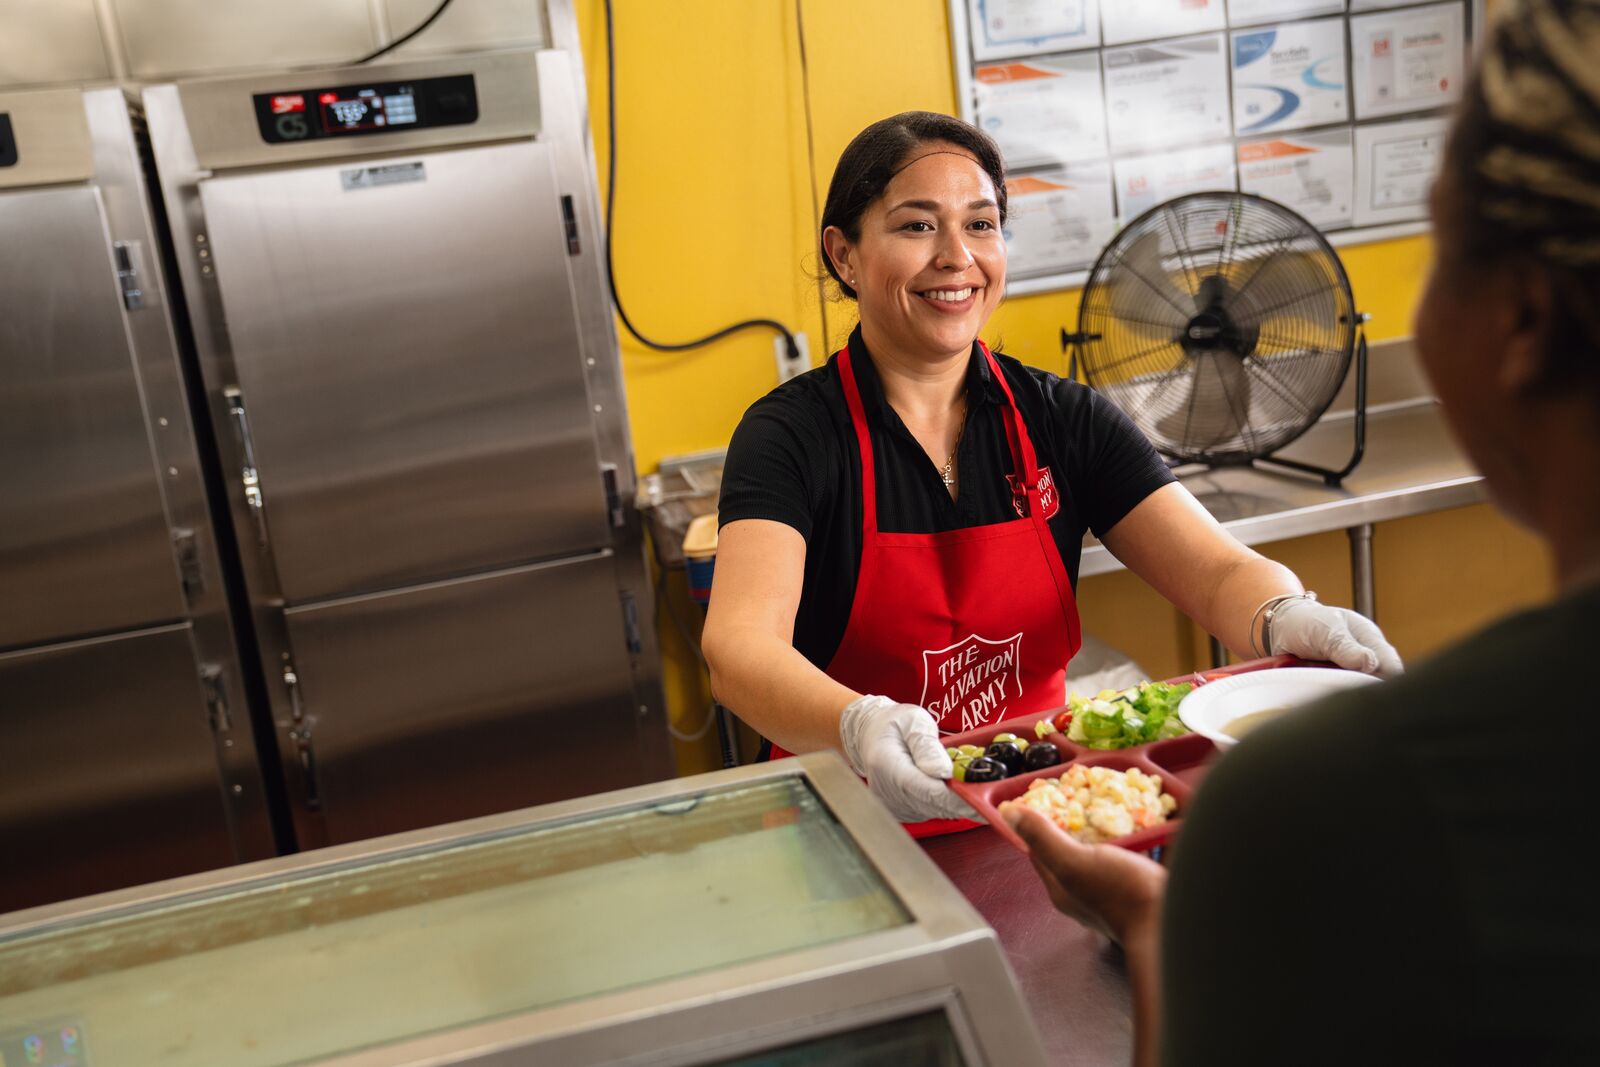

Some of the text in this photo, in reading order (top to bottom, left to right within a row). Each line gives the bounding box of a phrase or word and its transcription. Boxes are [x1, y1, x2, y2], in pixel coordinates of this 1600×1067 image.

[927, 643, 1014, 725] SALVATION
[938, 645, 980, 687] THE
[961, 672, 1008, 734] ARMY
